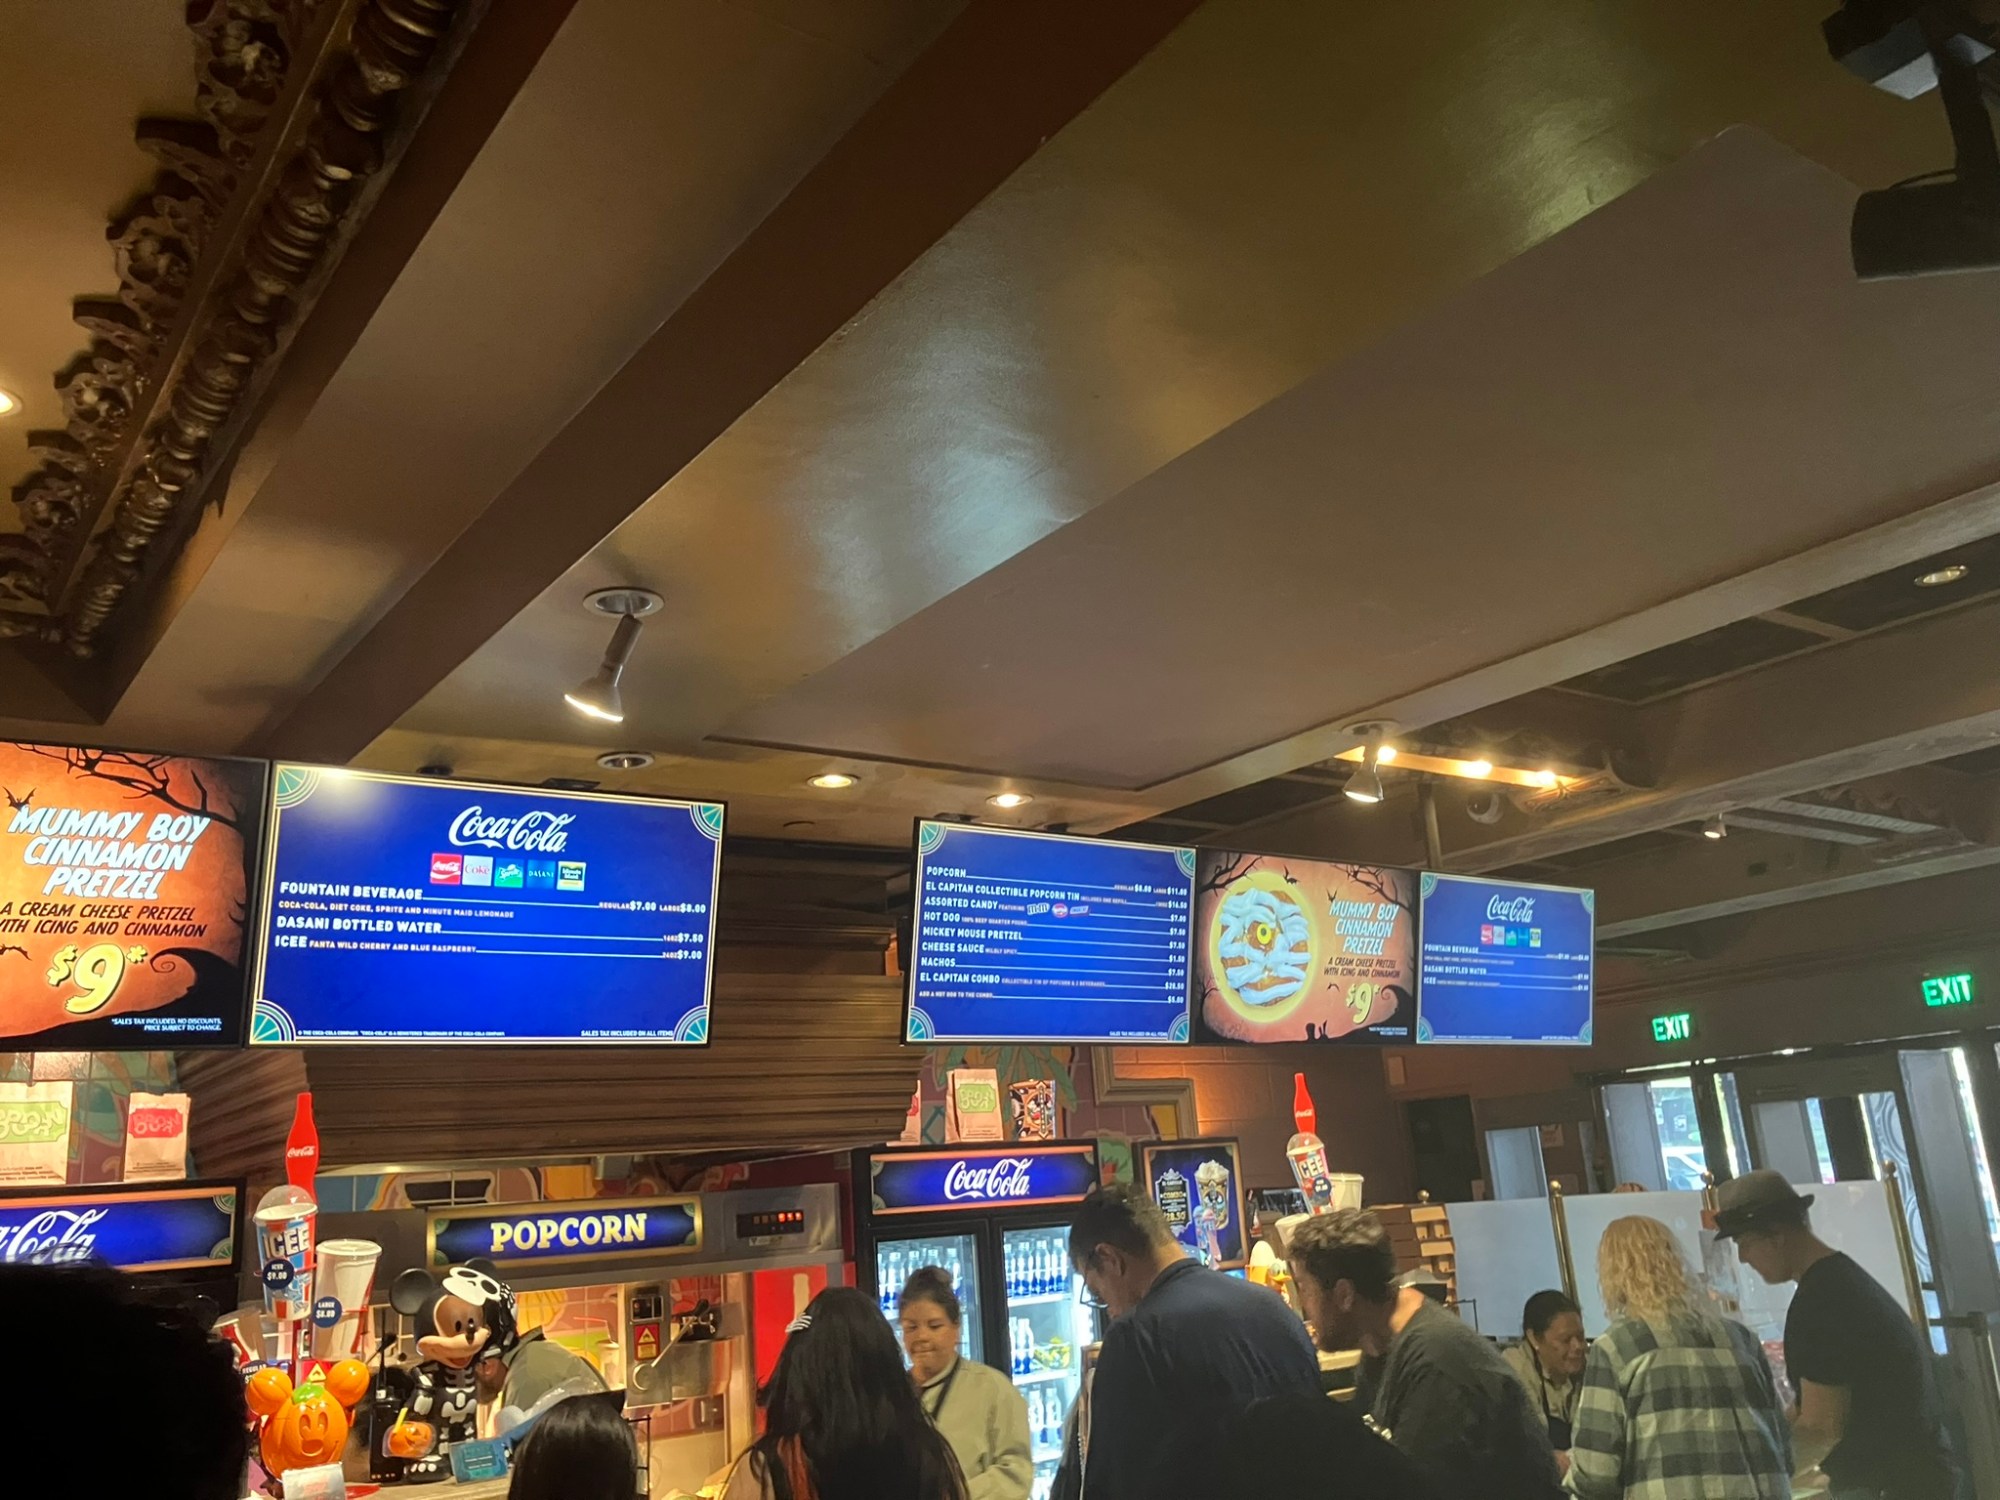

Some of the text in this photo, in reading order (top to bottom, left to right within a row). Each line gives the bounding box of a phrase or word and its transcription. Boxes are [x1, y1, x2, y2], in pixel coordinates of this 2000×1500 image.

[8, 805, 210, 844] MUMMY BOY
[448, 805, 576, 853] Coca-Cola
[23, 836, 194, 871] CINNAMON
[927, 866, 966, 877] POPCORN
[42, 867, 166, 900] PRETZEL
[280, 882, 349, 897] FOUNTAIN
[353, 885, 423, 900] BEVERAGE
[926, 881, 936, 891] EL
[938, 882, 974, 893] CAPITAN
[975, 885, 1028, 897] COLLECTIBLE
[1030, 889, 1065, 900] POPCORN
[1067, 892, 1080, 901] TIN
[1, 902, 196, 921] A CREAM CHEESE PRETZEL
[279, 901, 328, 911] COCA-COLA,
[330, 903, 348, 911] DIET
[375, 905, 403, 913] SPRITE
[405, 906, 421, 914] AND
[423, 907, 452, 916] MINUTE
[454, 909, 473, 917] MAID
[474, 910, 514, 918] LEMONADE
[924, 896, 968, 908] ASSORTED
[970, 899, 998, 910] CANDY
[1329, 900, 1399, 921] MUMMY BOY
[1487, 894, 1536, 923] Coca-Cola
[277, 915, 330, 929] DASANI
[333, 917, 394, 932] BOTTLED
[397, 921, 442, 934] WATER
[924, 912, 941, 921] HOT
[943, 912, 960, 922] DOG
[34, 920, 79, 933] ICING
[83, 921, 119, 935] AND
[124, 922, 207, 937] CINNAMON
[923, 927, 956, 937] MICKEY
[957, 928, 986, 938] MOUSE
[988, 930, 1023, 940] PRETZEL
[1335, 919, 1394, 937] CINNAMON
[275, 935, 308, 947] ICEE
[309, 940, 335, 949] FANTA
[337, 941, 358, 949] WILD
[359, 942, 391, 950] CHERRY
[392, 943, 408, 951] AND
[432, 945, 476, 953] RASPBERRY
[922, 942, 955, 952] CHEESE
[957, 943, 985, 953] SAUCE
[1343, 936, 1384, 955] PRETZEL
[1425, 943, 1479, 954] FOUNTAIN BEVERAGE
[921, 957, 956, 967] NACHOS
[1328, 957, 1396, 969] A CREAM CHEESE PRETZEL
[1424, 965, 1487, 975] DASANI BOTTLED WATER
[920, 972, 931, 982] EL
[933, 972, 969, 983] CAPITAN
[971, 974, 1000, 984] COMBO
[1324, 967, 1400, 978] WITH ICING AND CINNAMON
[1922, 974, 1972, 1006] EXIT
[1652, 1014, 1690, 1041] EXIT
[1298, 1156, 1325, 1179] CEE
[944, 1158, 1033, 1200] Coca-Cola
[263, 1221, 310, 1259] ICEE
[490, 1213, 647, 1252] POPCORN
